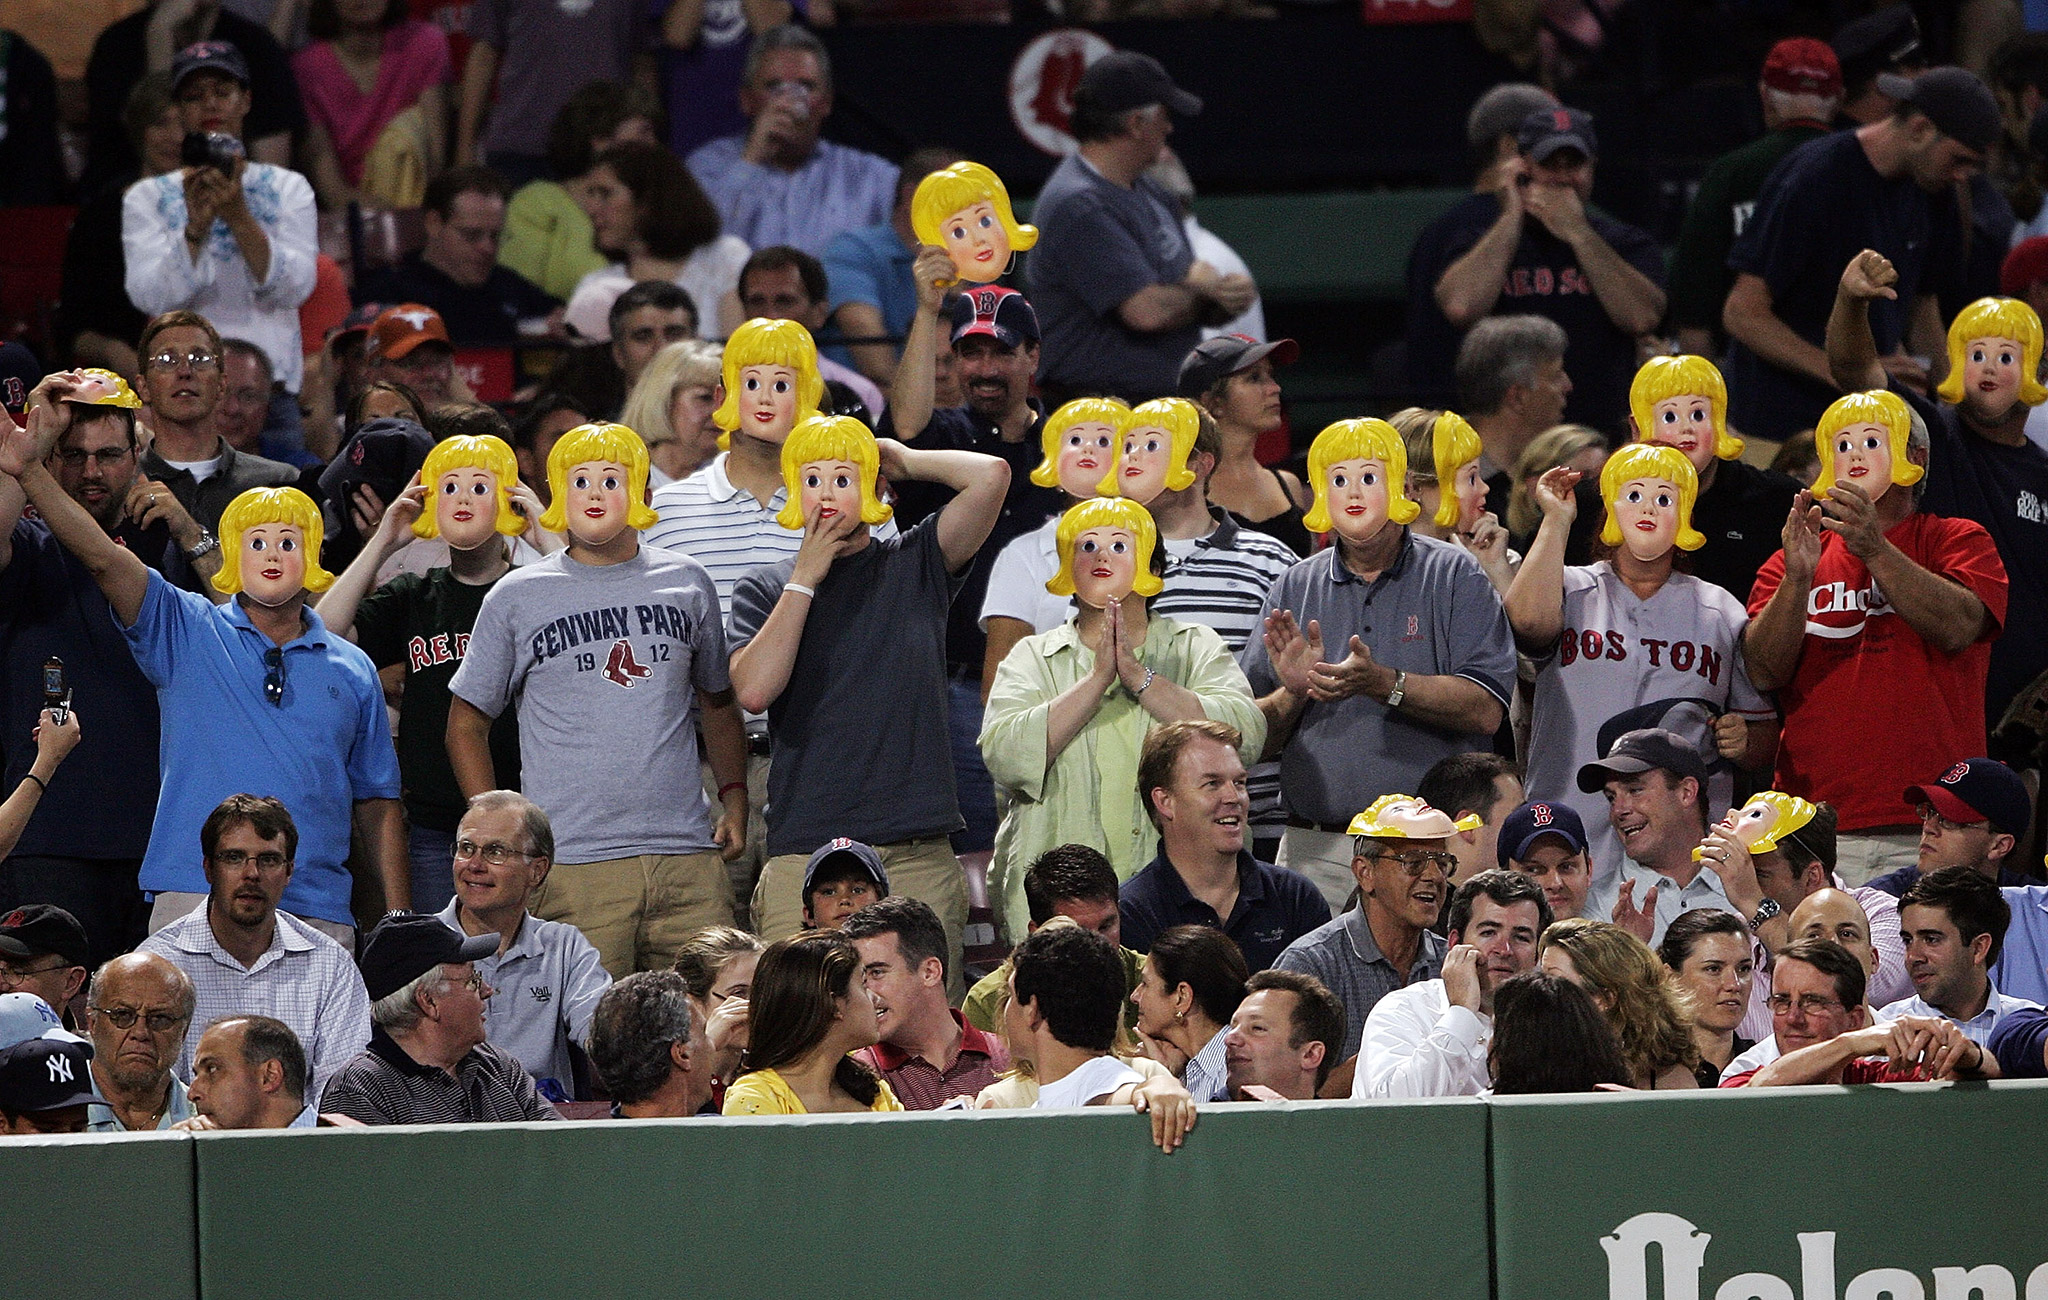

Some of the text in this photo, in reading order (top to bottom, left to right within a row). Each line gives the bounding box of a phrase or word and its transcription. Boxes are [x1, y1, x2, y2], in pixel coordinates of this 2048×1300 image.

[977, 290, 997, 315] B
[3, 377, 26, 407] B
[532, 606, 631, 666] FENWAY
[574, 643, 671, 672] 19 12
[1560, 628, 1722, 686] BOSTON
[1941, 762, 1970, 784] B
[1530, 803, 1553, 827] B
[46, 1053, 74, 1083] NY
